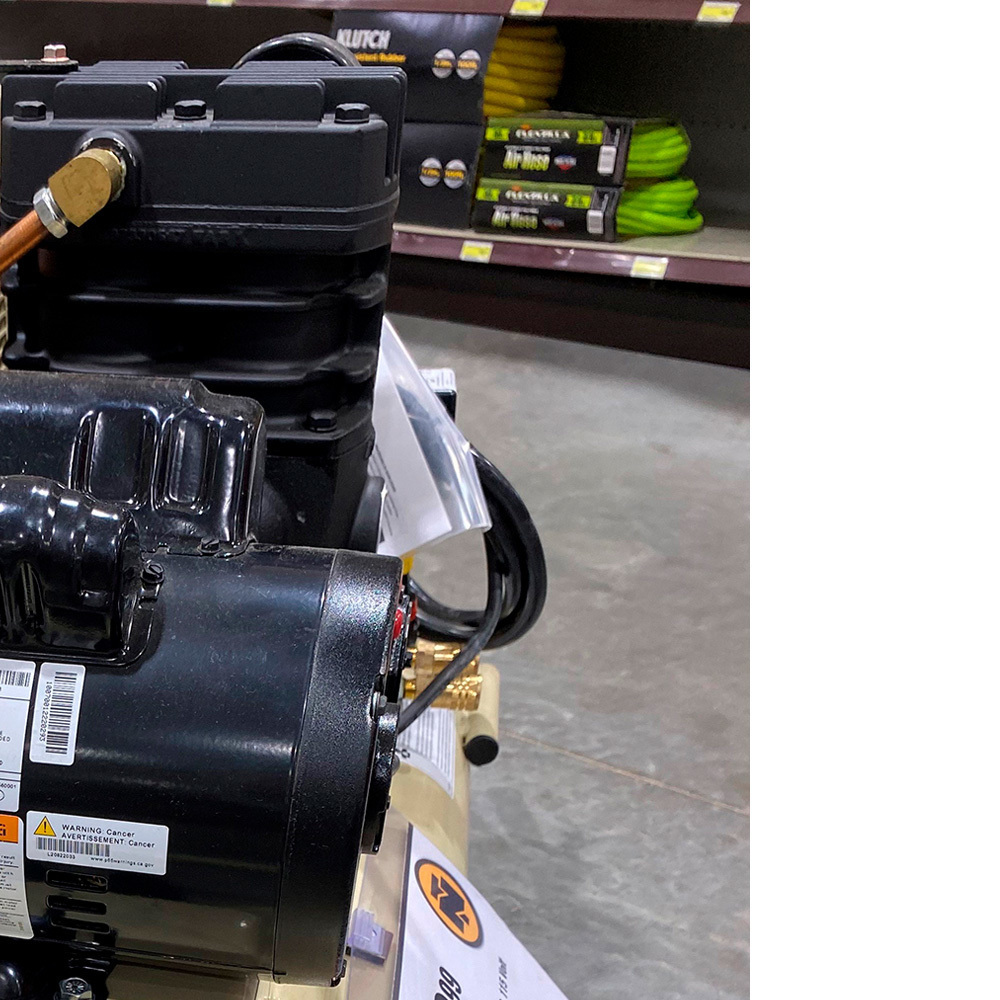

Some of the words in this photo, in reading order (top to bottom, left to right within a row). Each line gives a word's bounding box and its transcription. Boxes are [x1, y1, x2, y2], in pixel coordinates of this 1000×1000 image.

[337, 29, 391, 49] KLUTCH
[106, 828, 135, 838] Cancer
[128, 840, 155, 848] Cancer
[499, 976, 507, 999] 115
